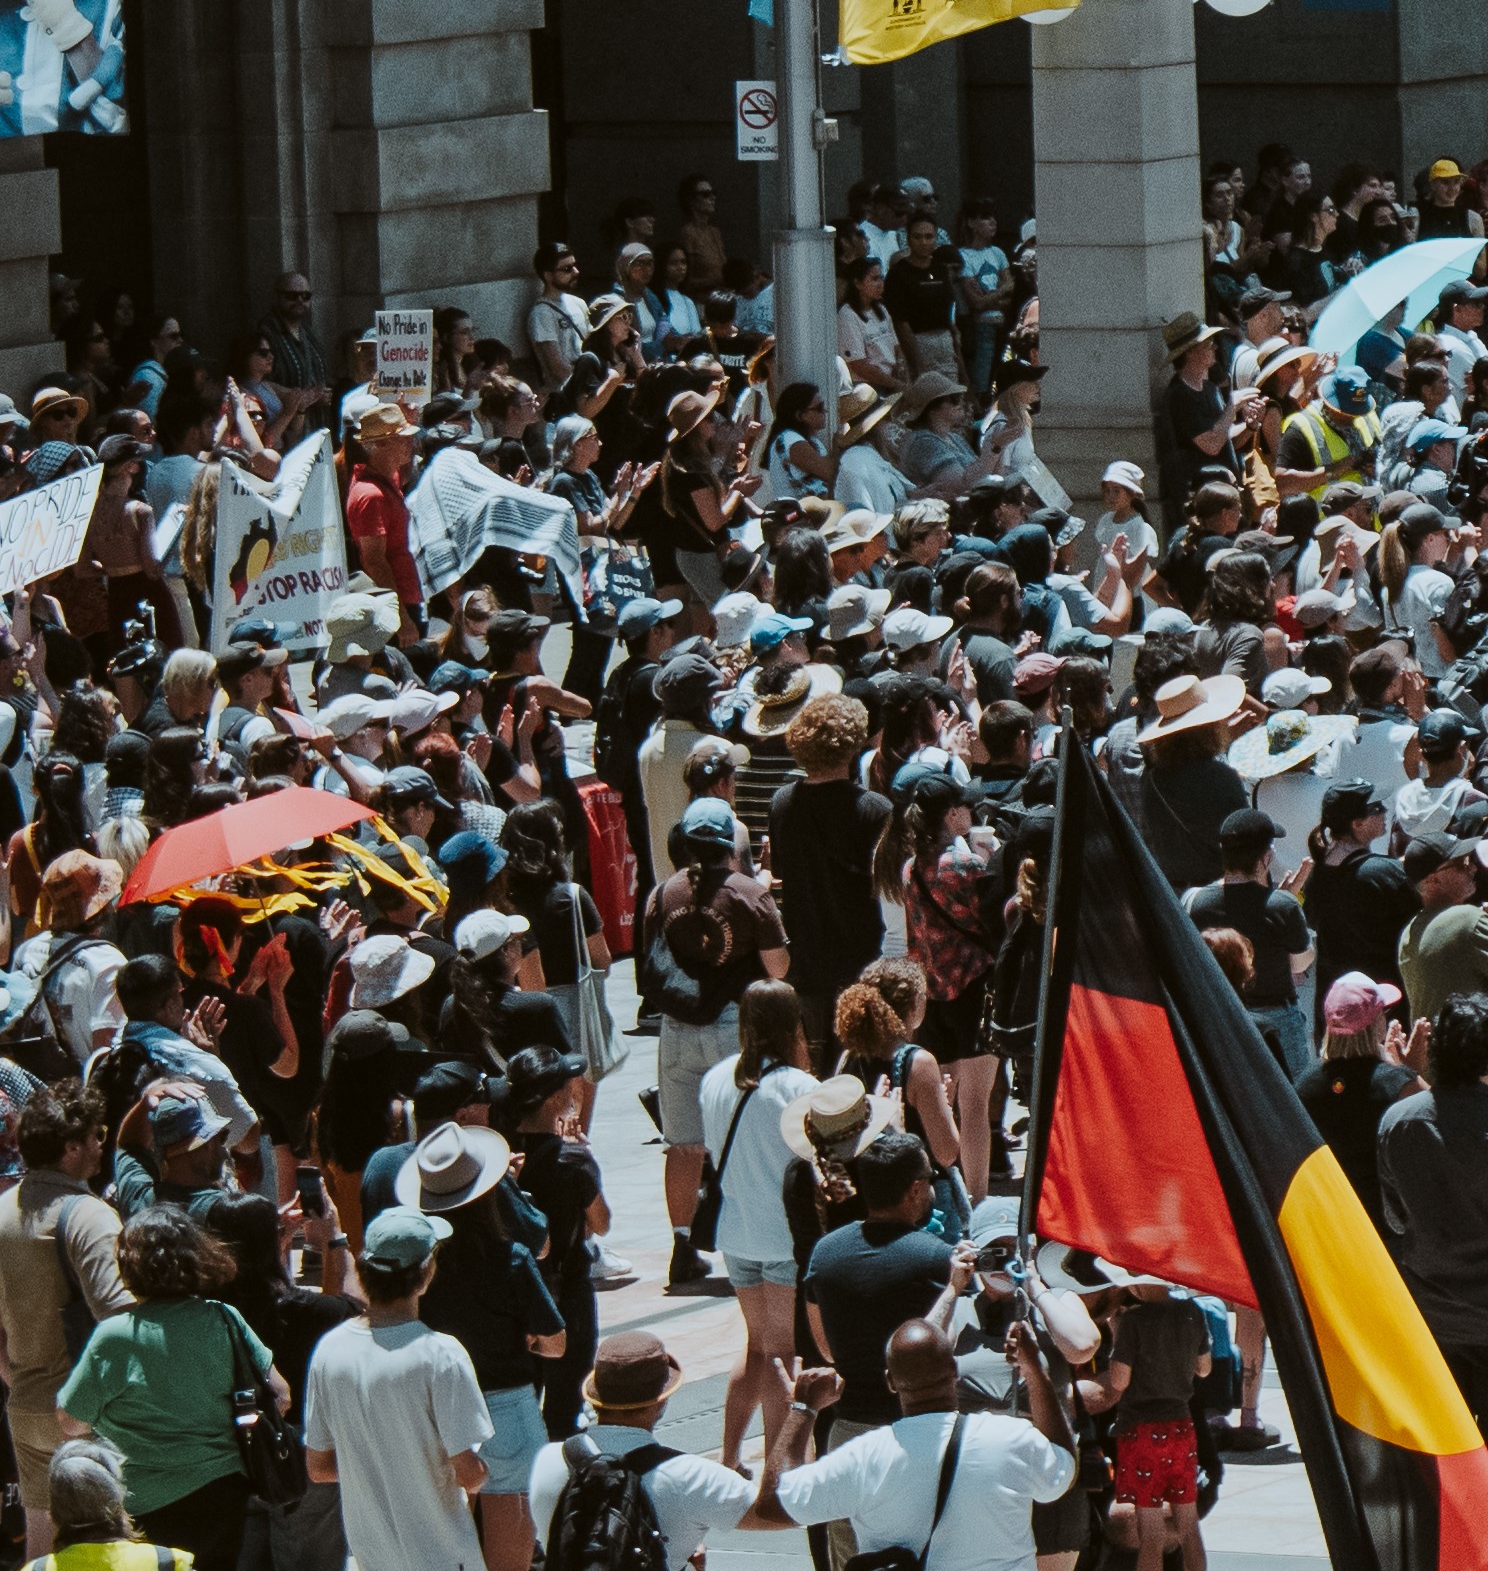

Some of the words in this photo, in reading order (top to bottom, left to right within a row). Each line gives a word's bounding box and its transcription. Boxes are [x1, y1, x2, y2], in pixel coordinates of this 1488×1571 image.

[753, 136, 766, 145] NO
[378, 315, 392, 336] No
[393, 313, 417, 336] Pride
[418, 317, 428, 335] in
[381, 339, 429, 362] Genocide
